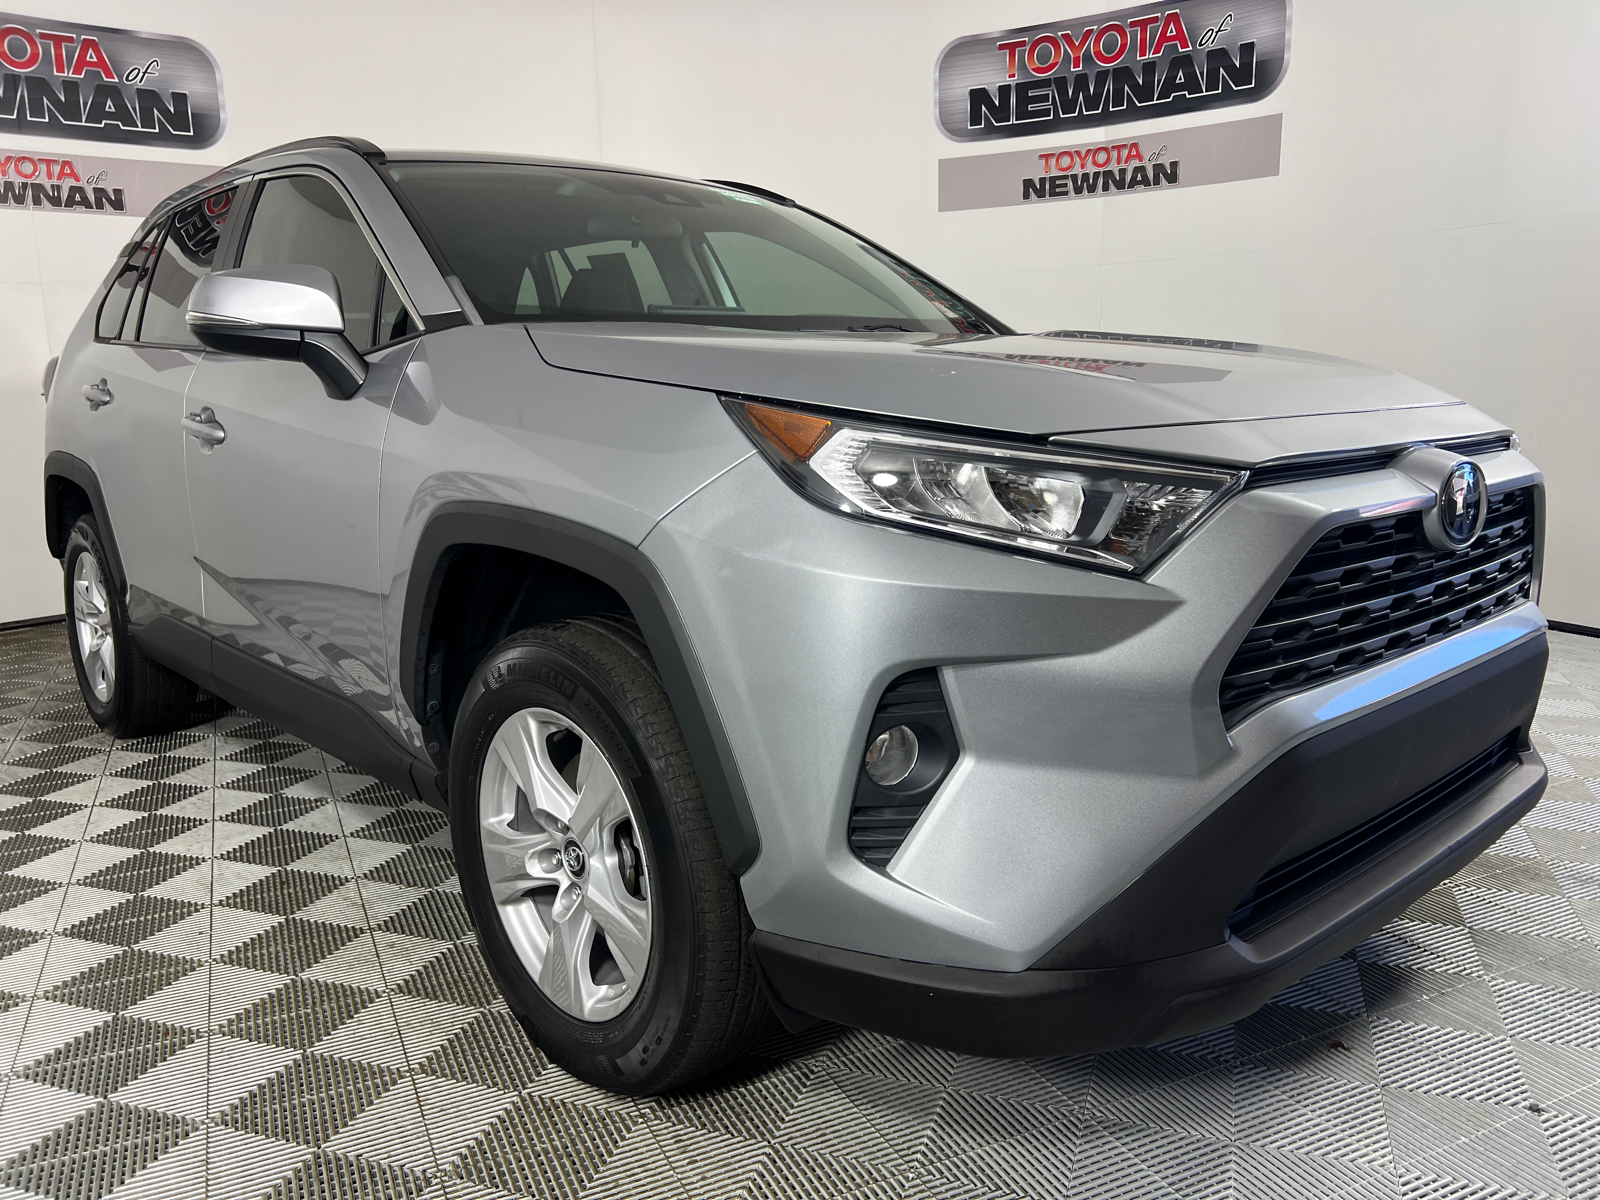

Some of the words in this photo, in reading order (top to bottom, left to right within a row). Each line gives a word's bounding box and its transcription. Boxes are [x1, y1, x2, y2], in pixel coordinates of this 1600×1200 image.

[997, 9, 1192, 80] TOYOTA
[1197, 13, 1233, 49] of
[124, 59, 160, 85] of
[967, 41, 1256, 129] NEWNAN
[1038, 141, 1144, 174] TOYOTA
[1148, 145, 1167, 163] of
[86, 170, 107, 185] of
[1022, 159, 1180, 201] NEWNAN
[506, 662, 575, 696] MICHELIN
[584, 700, 617, 740] 225/65
[615, 742, 624, 753] R
